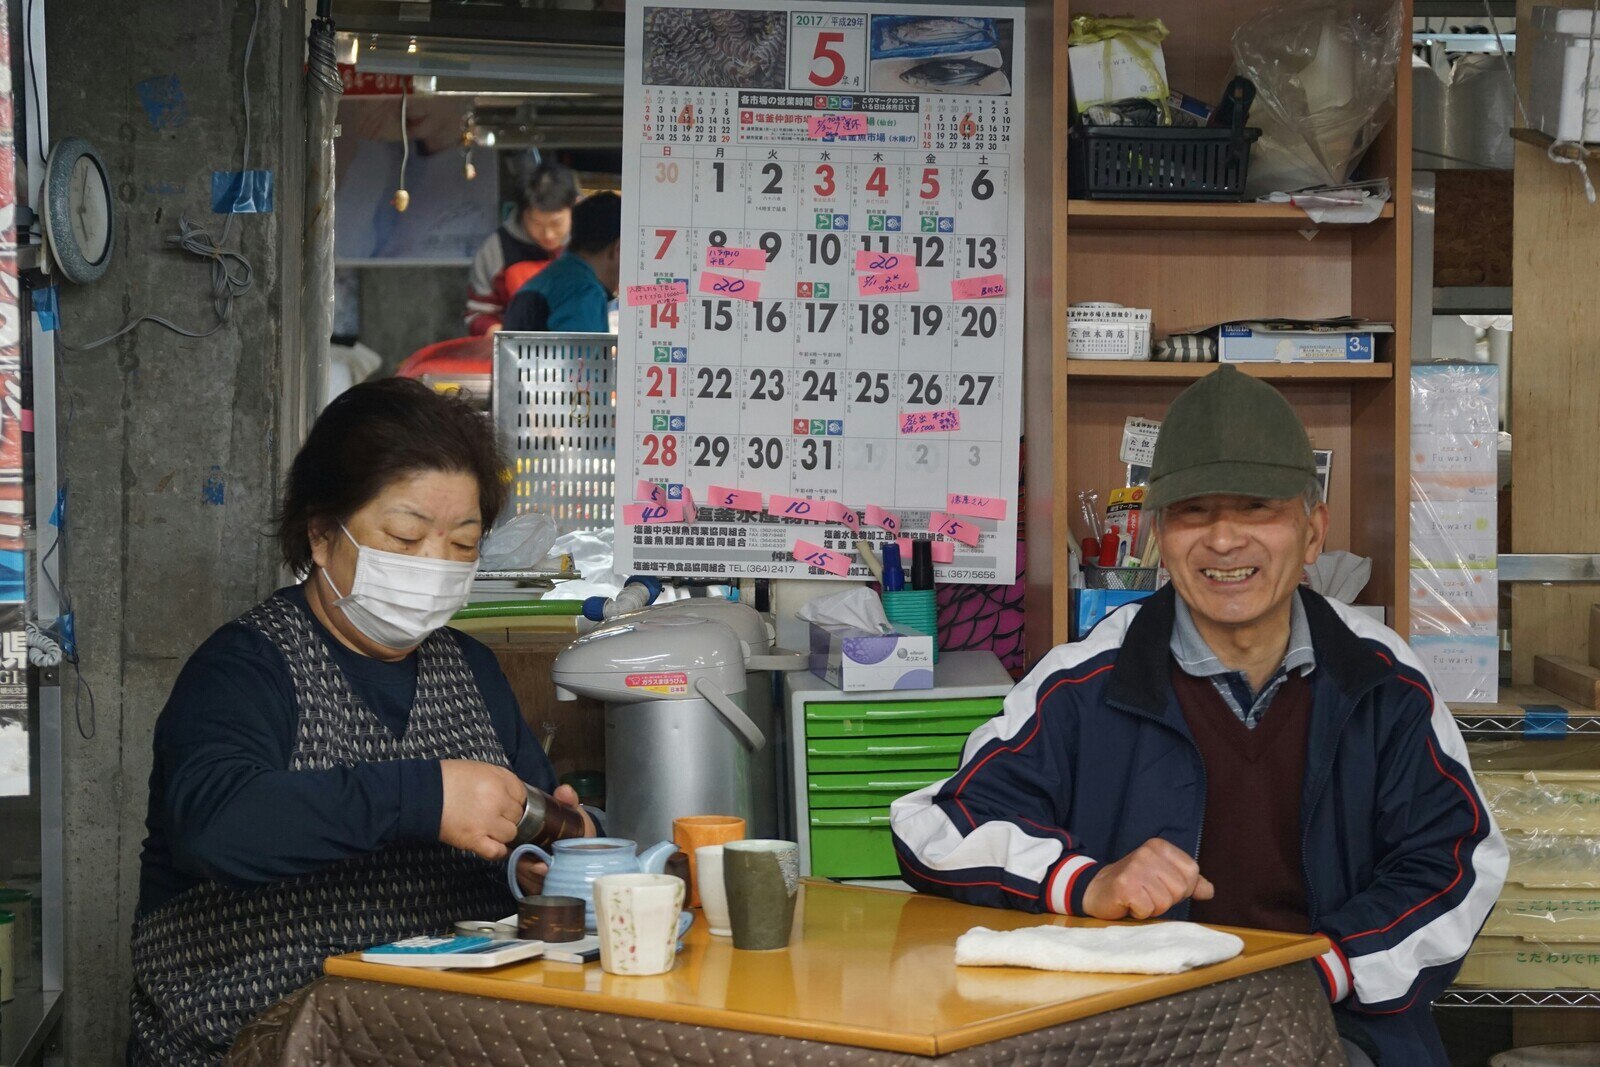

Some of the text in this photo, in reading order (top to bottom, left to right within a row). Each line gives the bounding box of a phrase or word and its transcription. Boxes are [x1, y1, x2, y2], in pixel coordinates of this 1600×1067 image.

[796, 15, 865, 27] 2017 平成29年
[808, 32, 845, 87] 5
[741, 95, 813, 107] 各市場の営業時間
[663, 146, 988, 165] 日 月 火 水 木 金 土
[655, 162, 995, 200] 30 1 2 3 4 5 6
[654, 230, 677, 260] 7
[760, 232, 782, 263] 9
[807, 233, 841, 266] 10
[913, 236, 945, 267] 12
[966, 237, 998, 269] 13
[869, 255, 899, 270] 20
[713, 278, 745, 293] 20
[650, 300, 998, 339] 14 15 16 17 18 19 20
[1349, 336, 1361, 352] 3
[646, 365, 996, 406] 21 22 23 24 25 26 27
[642, 433, 981, 471] 28 29 30 31 1 2 3
[725, 493, 739, 505] 5
[641, 506, 669, 523] 40
[785, 501, 811, 514] 10
[842, 511, 854, 523] 10
[882, 517, 896, 529] 10
[633, 525, 747, 538] 塩釜中央鮮魚商業協同組合
[938, 519, 964, 535] 15
[633, 536, 747, 548] 塩釜魚類卸商業協同組合
[804, 551, 833, 567] 15
[633, 561, 726, 574] 塩釜塩干魚食品協同組合
[728, 565, 795, 575] TEL.(364)2417
[933, 569, 996, 580] EL.(367)5656
[1516, 952, 1600, 965] こだわりで作
